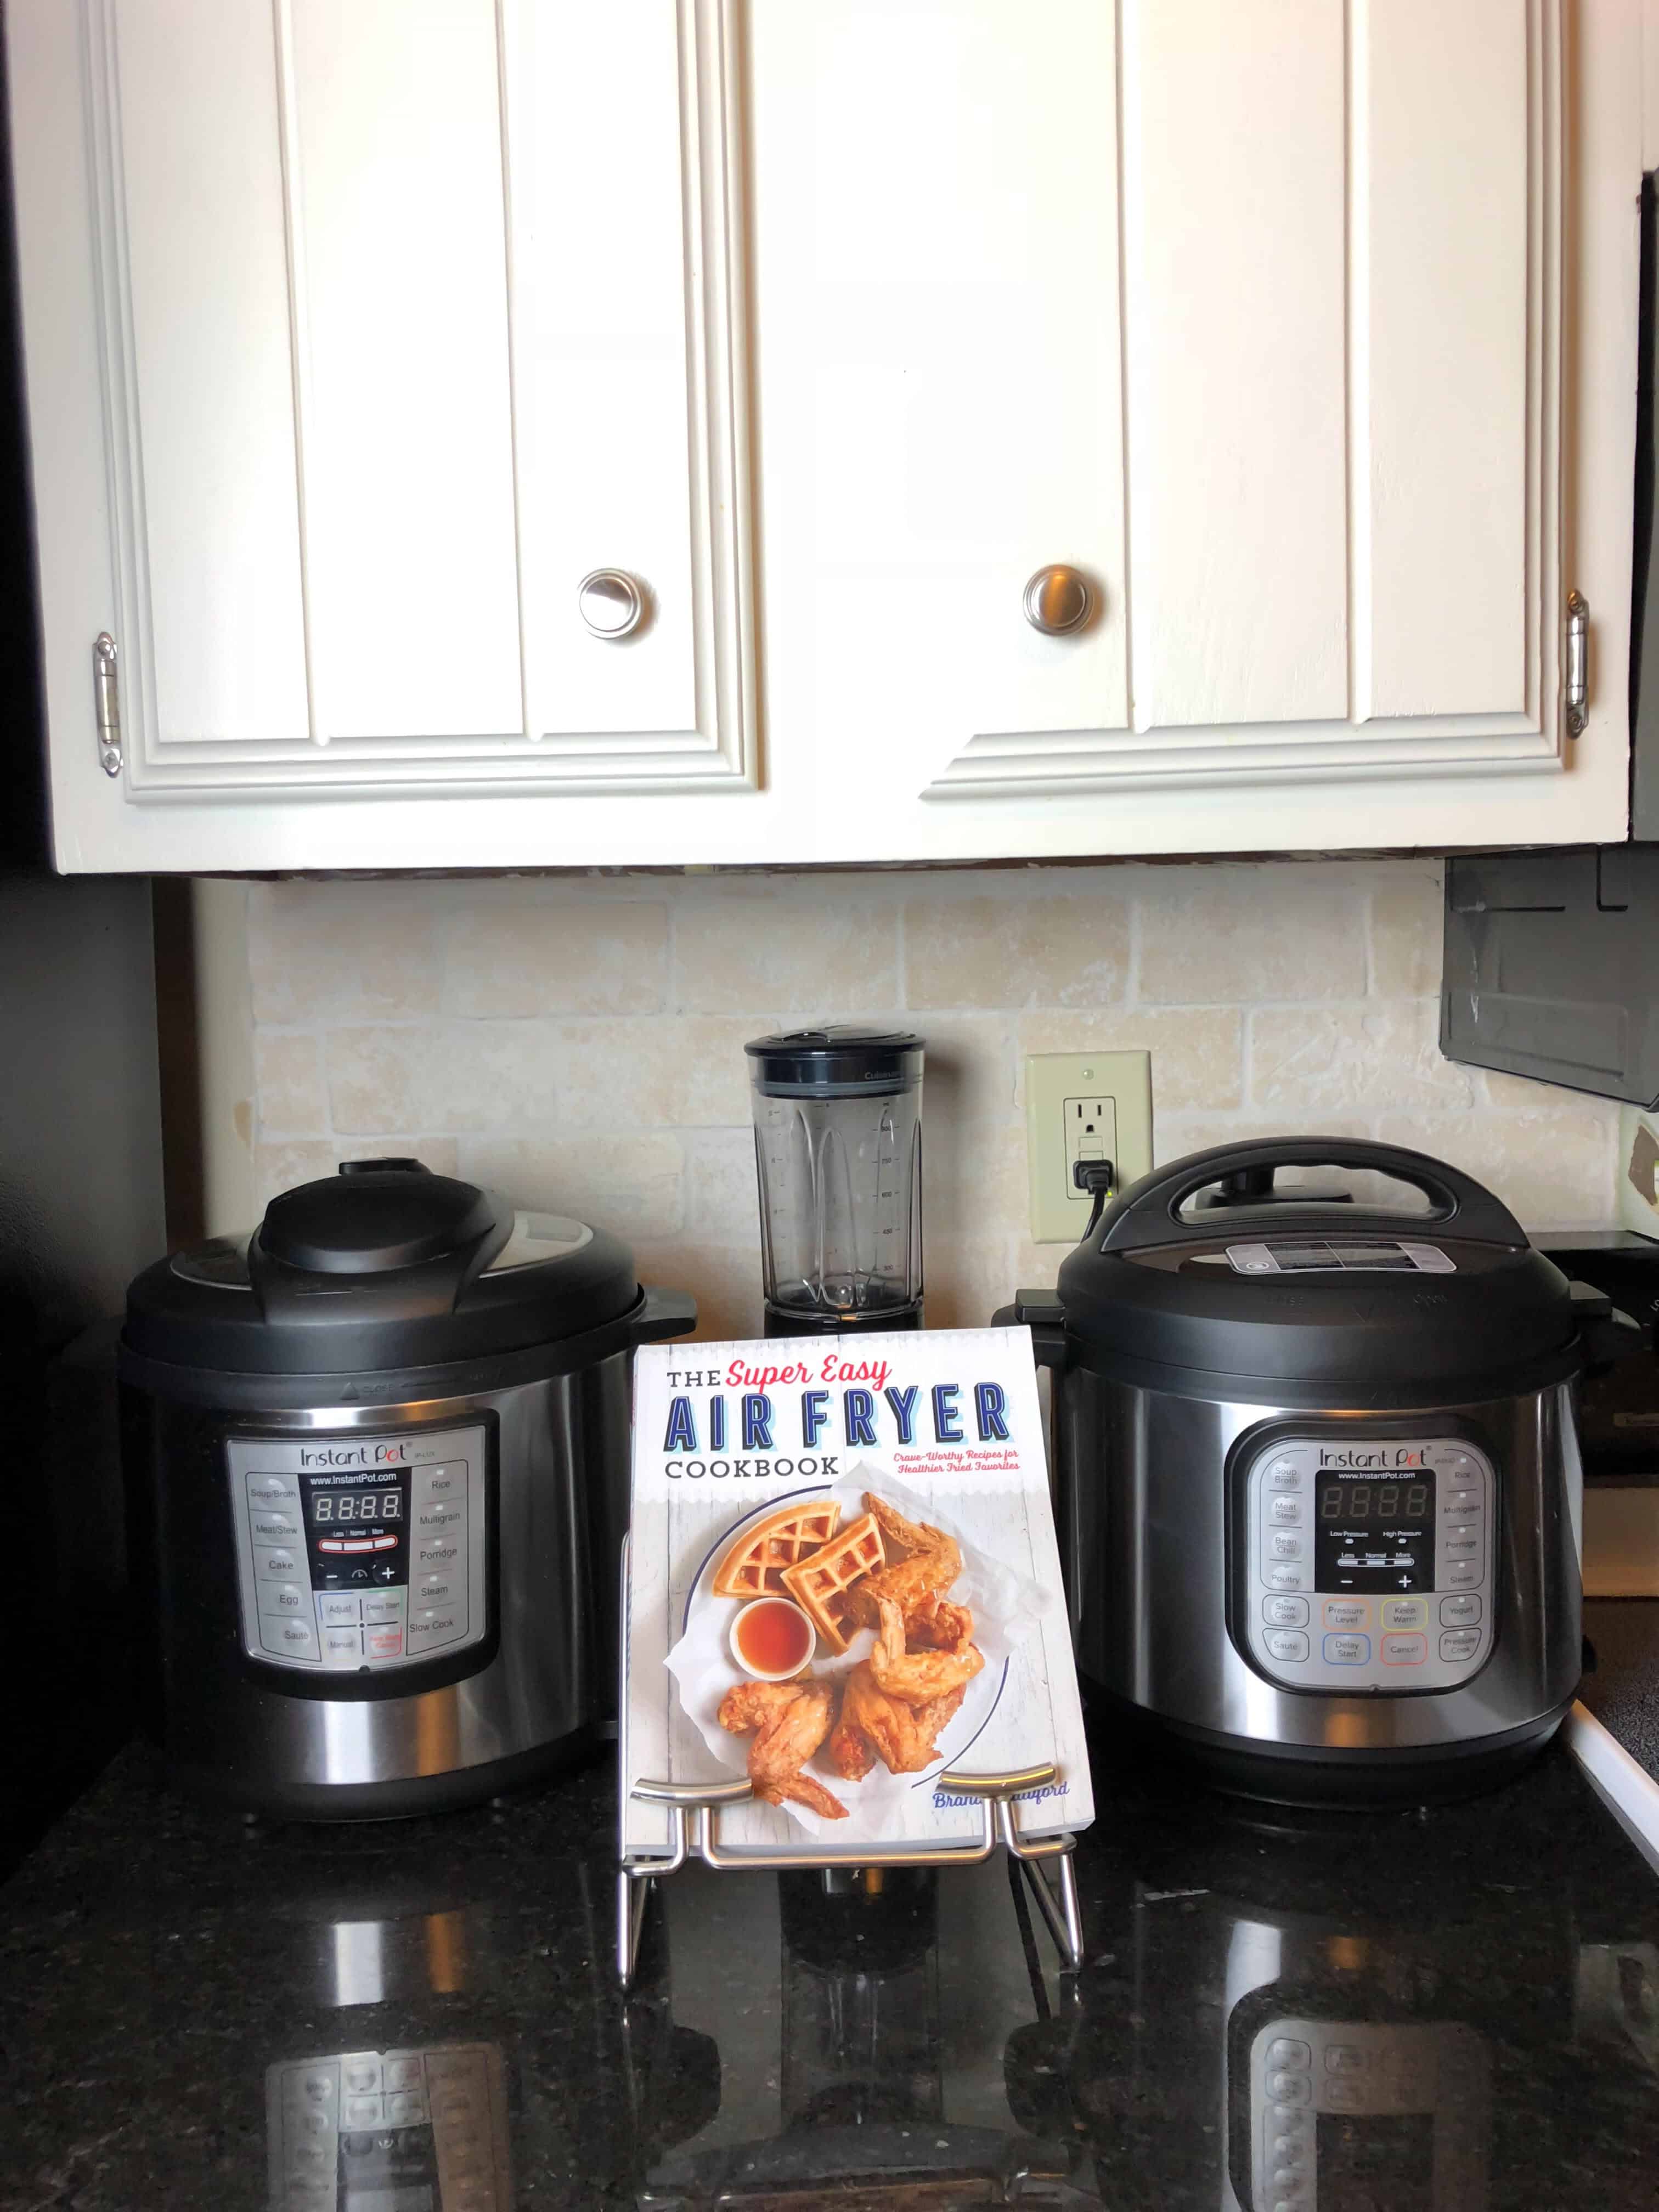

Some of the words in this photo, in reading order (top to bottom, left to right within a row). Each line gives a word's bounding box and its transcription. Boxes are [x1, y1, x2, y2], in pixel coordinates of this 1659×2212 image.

[667, 1369, 721, 1388] THE
[725, 1359, 814, 1395] Super
[821, 1354, 893, 1391] Easy
[663, 1392, 775, 1452] AIR
[801, 1381, 1012, 1447] FRYER
[301, 1447, 368, 1466] Instant
[375, 1444, 407, 1464] Pot
[893, 1452, 963, 1463] Crave-Worthy
[966, 1449, 1003, 1461] Recipes
[1004, 1449, 1019, 1461] for
[1320, 1448, 1388, 1467] Instant
[1396, 1448, 1427, 1467] Pot
[665, 1457, 839, 1479] COOKBOOK
[898, 1464, 945, 1474] Healthier
[946, 1462, 973, 1472] Fried
[974, 1461, 1020, 1471] Favorites
[1274, 1467, 1297, 1477] Soup
[311, 1471, 397, 1486] www.InstantPot.com
[1274, 1476, 1297, 1485] Broth
[431, 1480, 451, 1489] Rice
[250, 1488, 296, 1499] Soup/Broth
[1275, 1503, 1296, 1511] Meat
[420, 1512, 461, 1526] Multigrain
[1275, 1511, 1296, 1520] Stew
[256, 1525, 298, 1536] Meat/Stew
[1383, 1530, 1395, 1538] High
[1275, 1538, 1297, 1546] Bean
[420, 1547, 458, 1561] Porridge
[1277, 1545, 1296, 1554] Chili
[268, 1560, 294, 1570] Cake
[1272, 1575, 1300, 1586] Poultry
[421, 1585, 449, 1597] Steam
[279, 1594, 299, 1606] Egg
[329, 1604, 352, 1615] Adjust
[1275, 1602, 1296, 1612] Slow
[1328, 1606, 1365, 1615] Pressure
[1394, 1606, 1416, 1616] Keep
[1274, 1611, 1296, 1620] Cook
[1335, 1615, 1358, 1624] Level
[1393, 1615, 1417, 1623] Warm
[409, 1622, 430, 1633] Slow
[432, 1619, 455, 1630] Cook
[1335, 1640, 1359, 1651] Delay
[1338, 1649, 1357, 1658] Start
